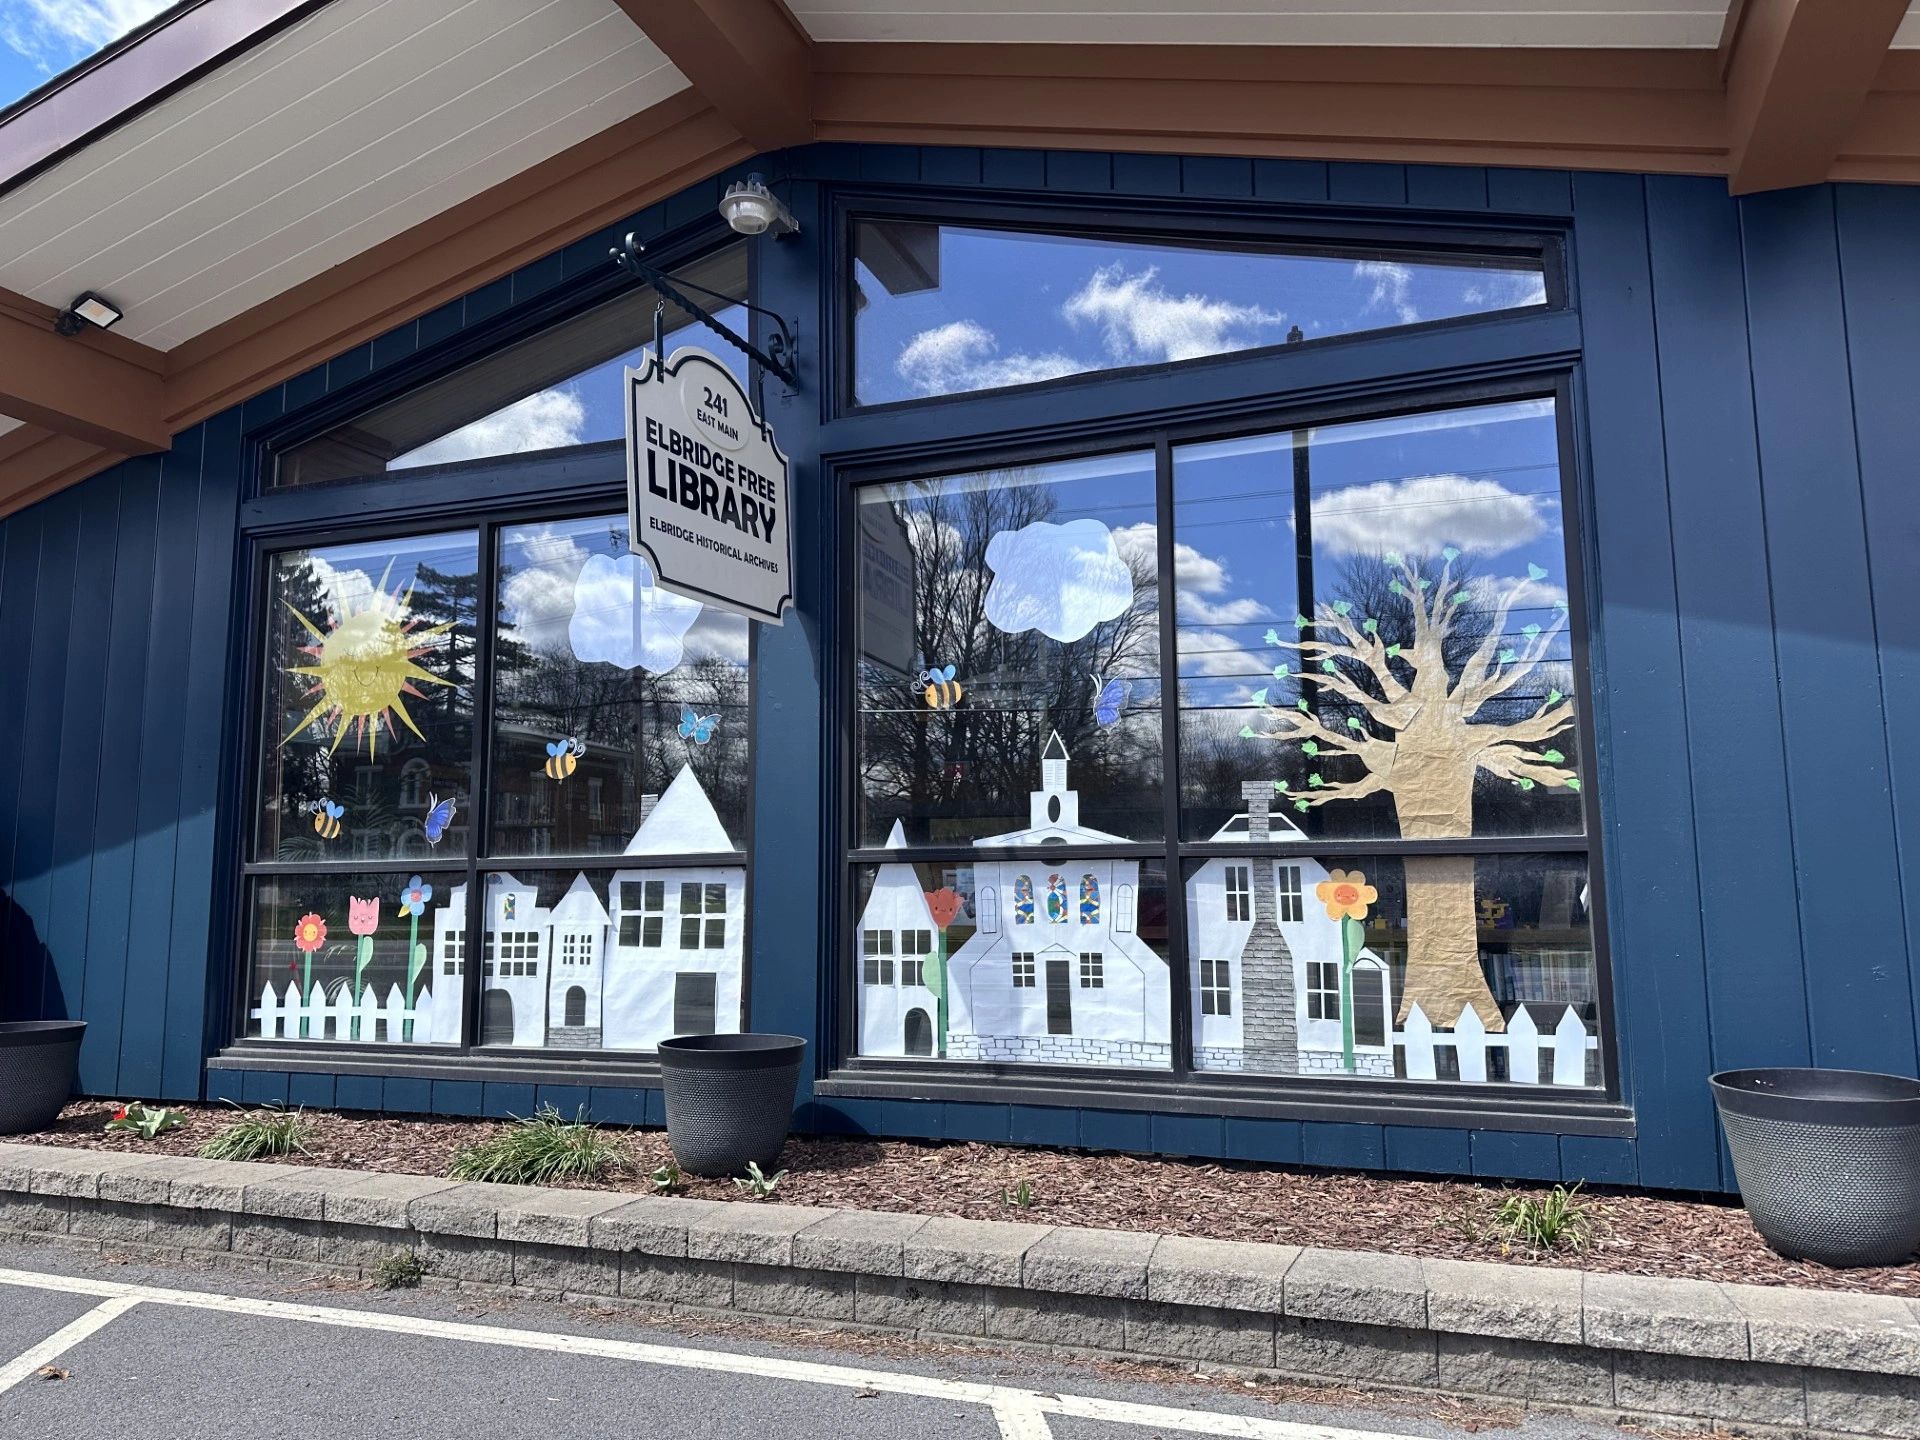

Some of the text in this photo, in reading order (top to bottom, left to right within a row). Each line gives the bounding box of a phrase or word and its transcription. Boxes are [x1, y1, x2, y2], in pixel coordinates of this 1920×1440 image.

[696, 408, 739, 441] EAST MAIN
[703, 386, 728, 417] 241
[645, 416, 776, 504] ELBRIDGE FREE
[647, 448, 776, 544] LIBRARY
[649, 516, 779, 574] ELBRIDGE HISTORICAL ARCHIVES
